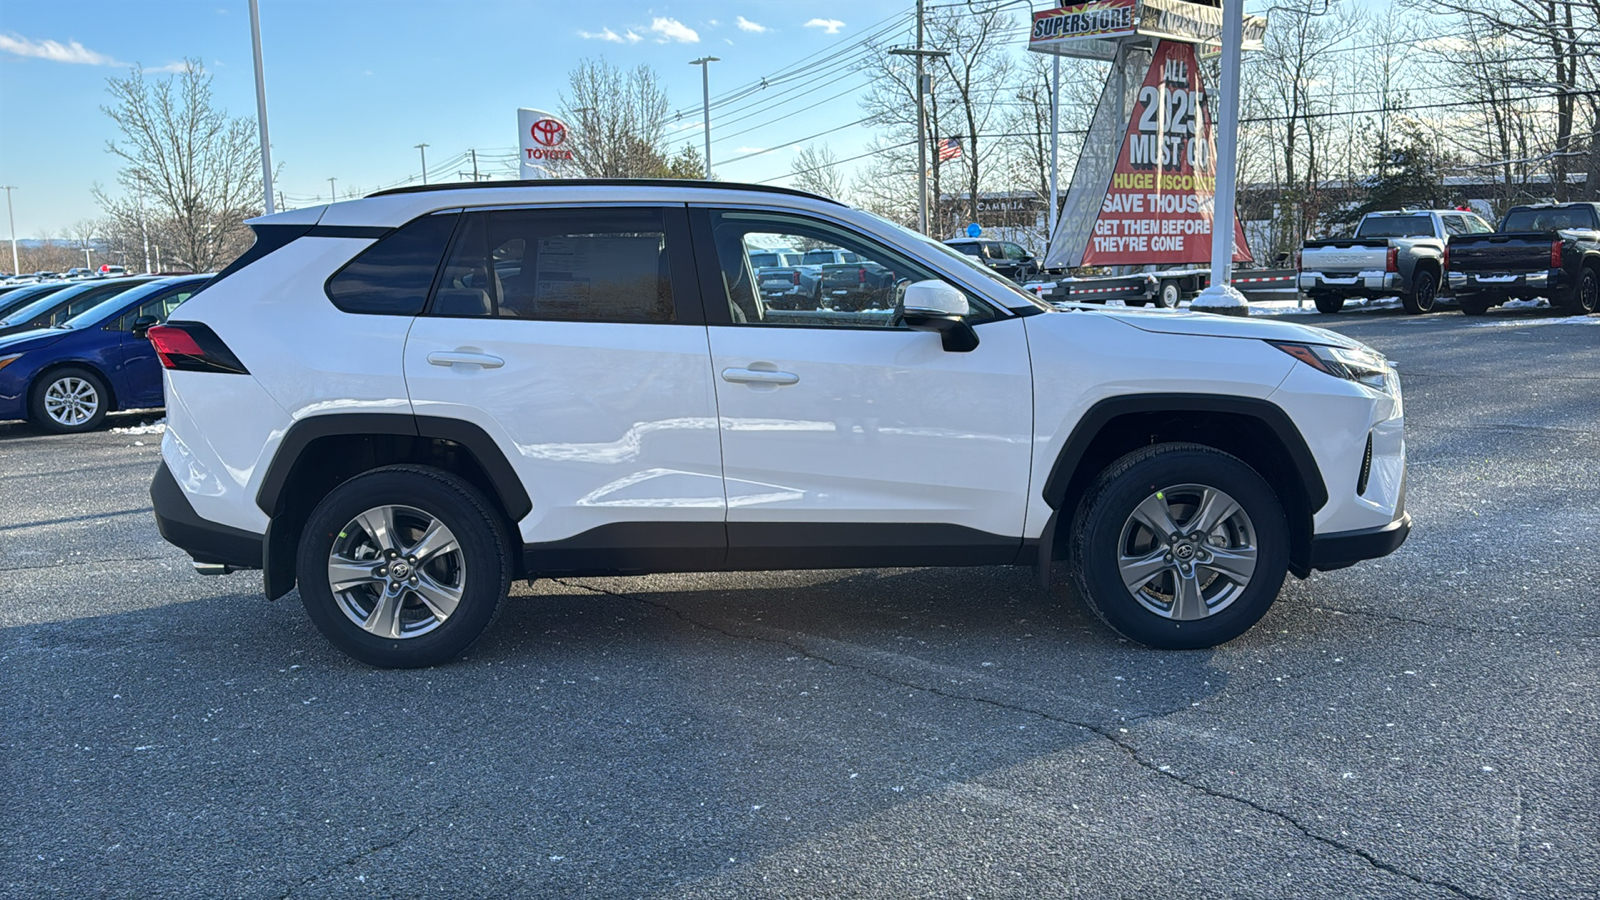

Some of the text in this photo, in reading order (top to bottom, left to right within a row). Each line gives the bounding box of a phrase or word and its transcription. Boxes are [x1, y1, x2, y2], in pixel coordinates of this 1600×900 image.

[1033, 6, 1132, 38] SUPERSTORE
[1163, 58, 1187, 83] ALL
[1138, 86, 1204, 135] 2025
[525, 148, 573, 160] TOYOTA
[1130, 134, 1182, 166] MUST
[1113, 173, 1154, 189] HUGE
[1102, 193, 1144, 213] SAVE
[1095, 219, 1119, 235] GET
[1121, 219, 1160, 235] THEM
[1162, 219, 1211, 235] BEFORE
[1093, 236, 1148, 252] THEY'RE
[1151, 236, 1184, 251] GONE
